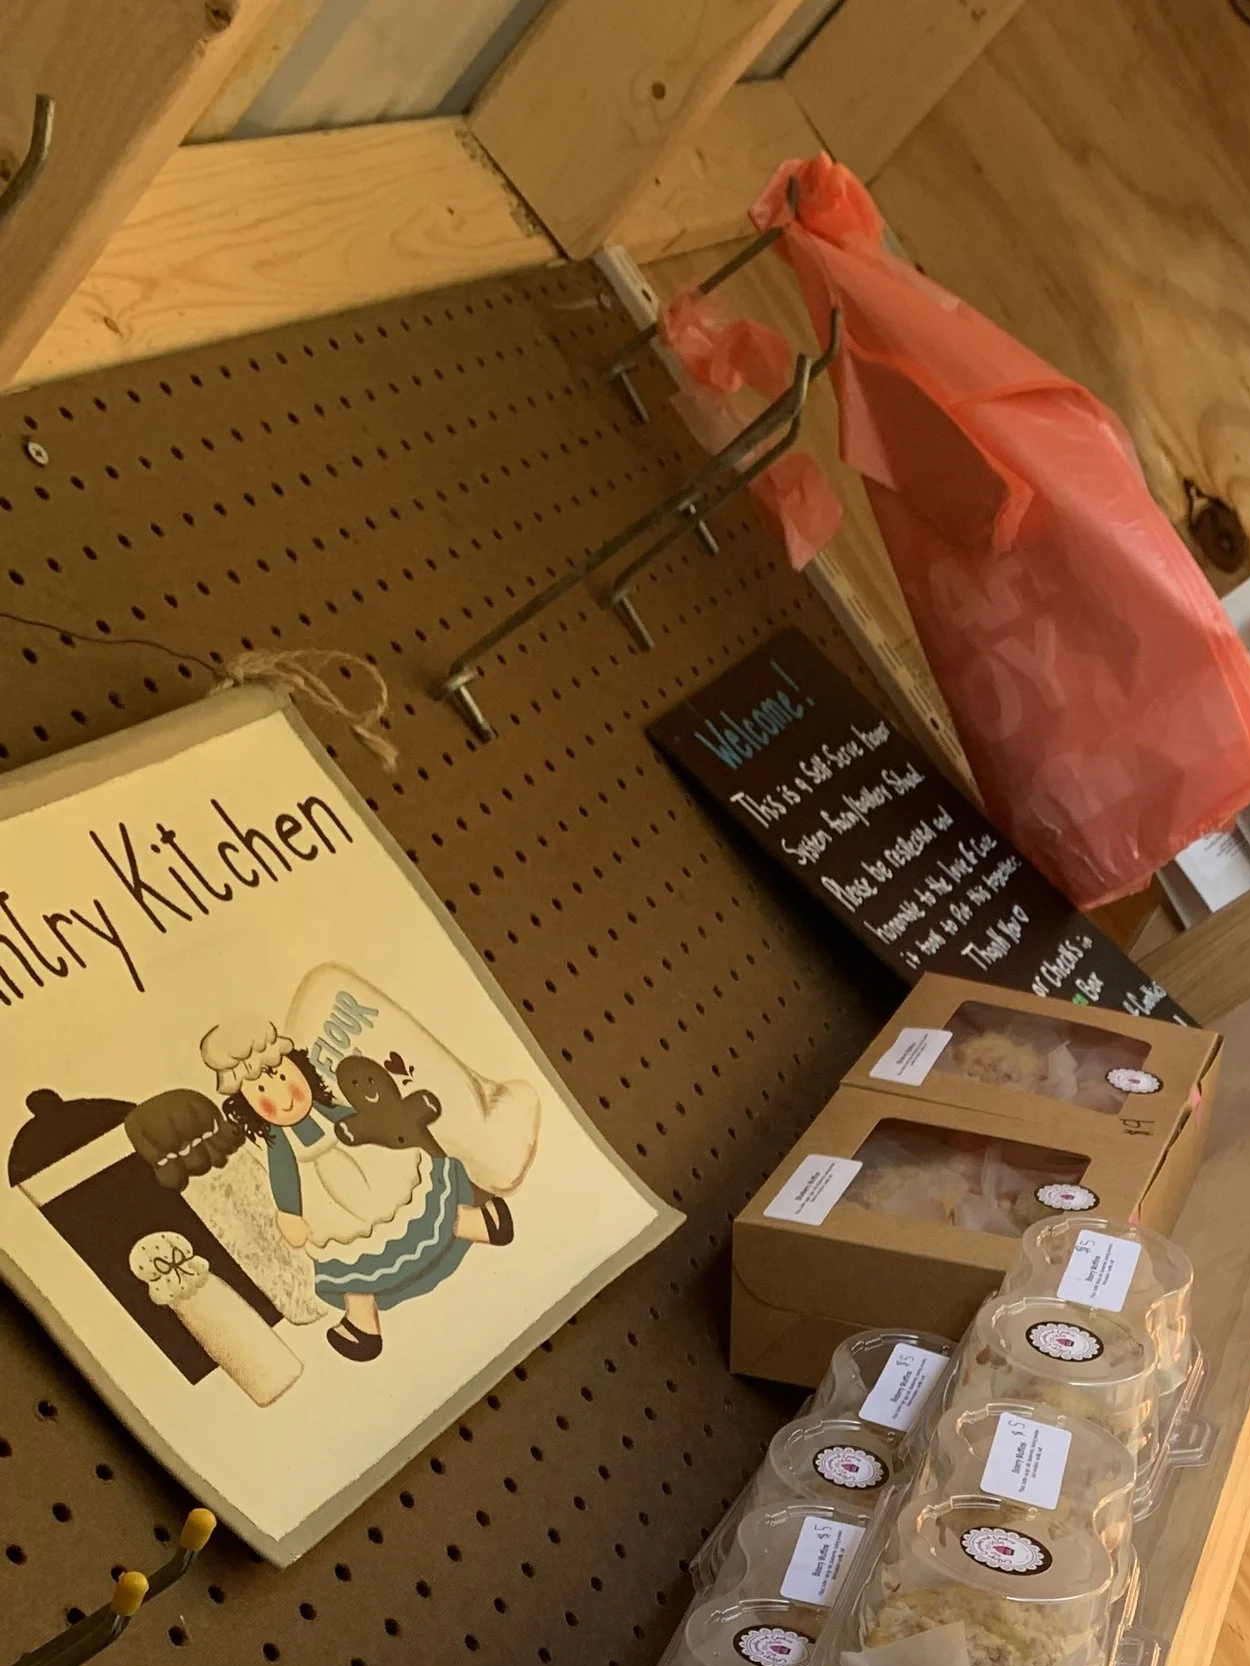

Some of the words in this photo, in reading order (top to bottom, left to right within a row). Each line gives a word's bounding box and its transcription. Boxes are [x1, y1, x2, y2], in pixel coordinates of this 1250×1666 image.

[696, 661, 815, 770] Welcome!
[731, 778, 789, 836] This
[775, 780, 801, 808] is
[0, 891, 145, 992] ntry
[89, 795, 354, 934] Kitchen
[820, 855, 880, 917] Please
[858, 848, 895, 888] be
[959, 923, 1015, 977] Thank
[1074, 968, 1109, 1005] Box
